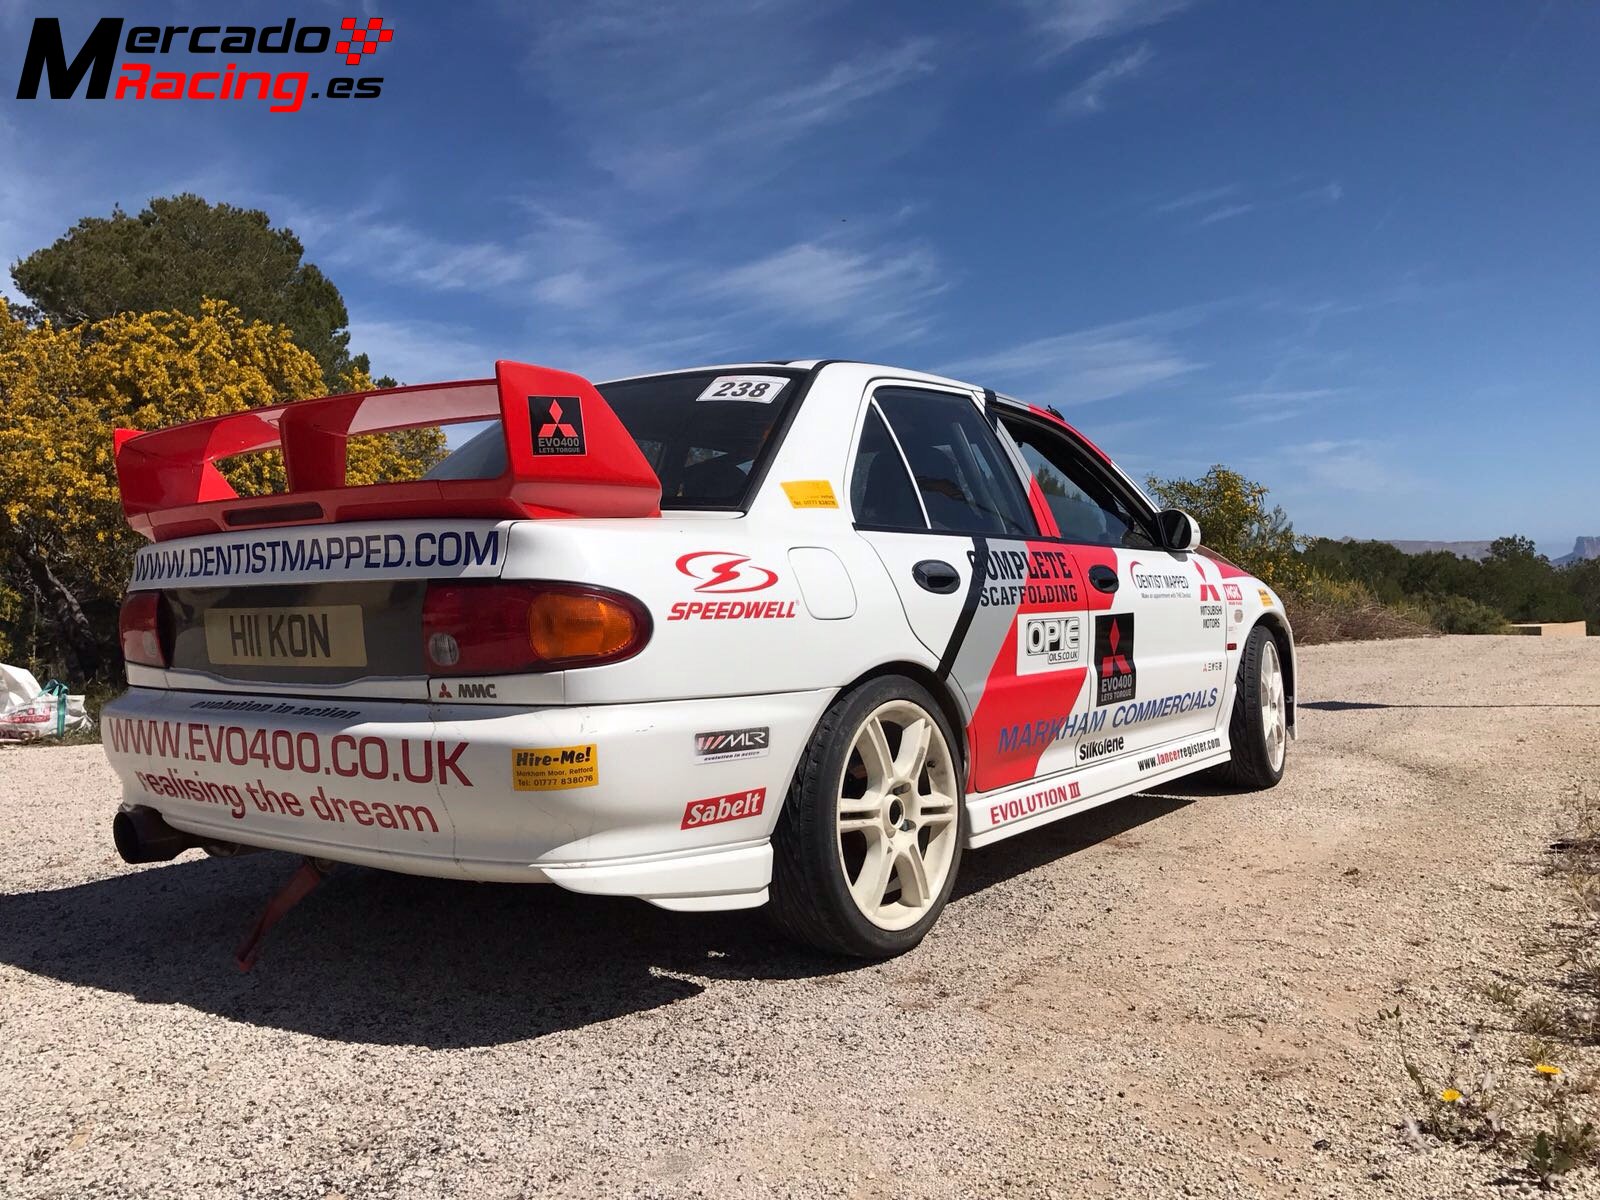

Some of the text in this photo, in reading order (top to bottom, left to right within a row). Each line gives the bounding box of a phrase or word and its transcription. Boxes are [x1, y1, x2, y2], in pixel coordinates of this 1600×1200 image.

[712, 382, 771, 398] 238
[538, 438, 580, 447] EVO400
[135, 530, 499, 582] WWW.DENTISTMAPPED.COM
[980, 584, 1079, 607] SCAFFOLDING
[667, 601, 796, 621] SPEEDWELL
[268, 614, 331, 658] KON
[1028, 619, 1080, 654] OPIE
[458, 683, 497, 699] MMC
[1101, 674, 1133, 693] EVO400
[190, 700, 361, 720] evolution in action
[998, 687, 1218, 753] MARKHAM COMMERCIALS
[109, 718, 473, 787] WWW.EVO400.CO.UK
[516, 746, 592, 767] Hire-Me!
[1137, 737, 1221, 772] www.lancerregister.com
[534, 777, 557, 786] 01777
[560, 775, 593, 785] 838076
[135, 768, 439, 833] realising the dream
[687, 791, 761, 825] Sabelt
[990, 781, 1082, 825] EVOLUTION III
